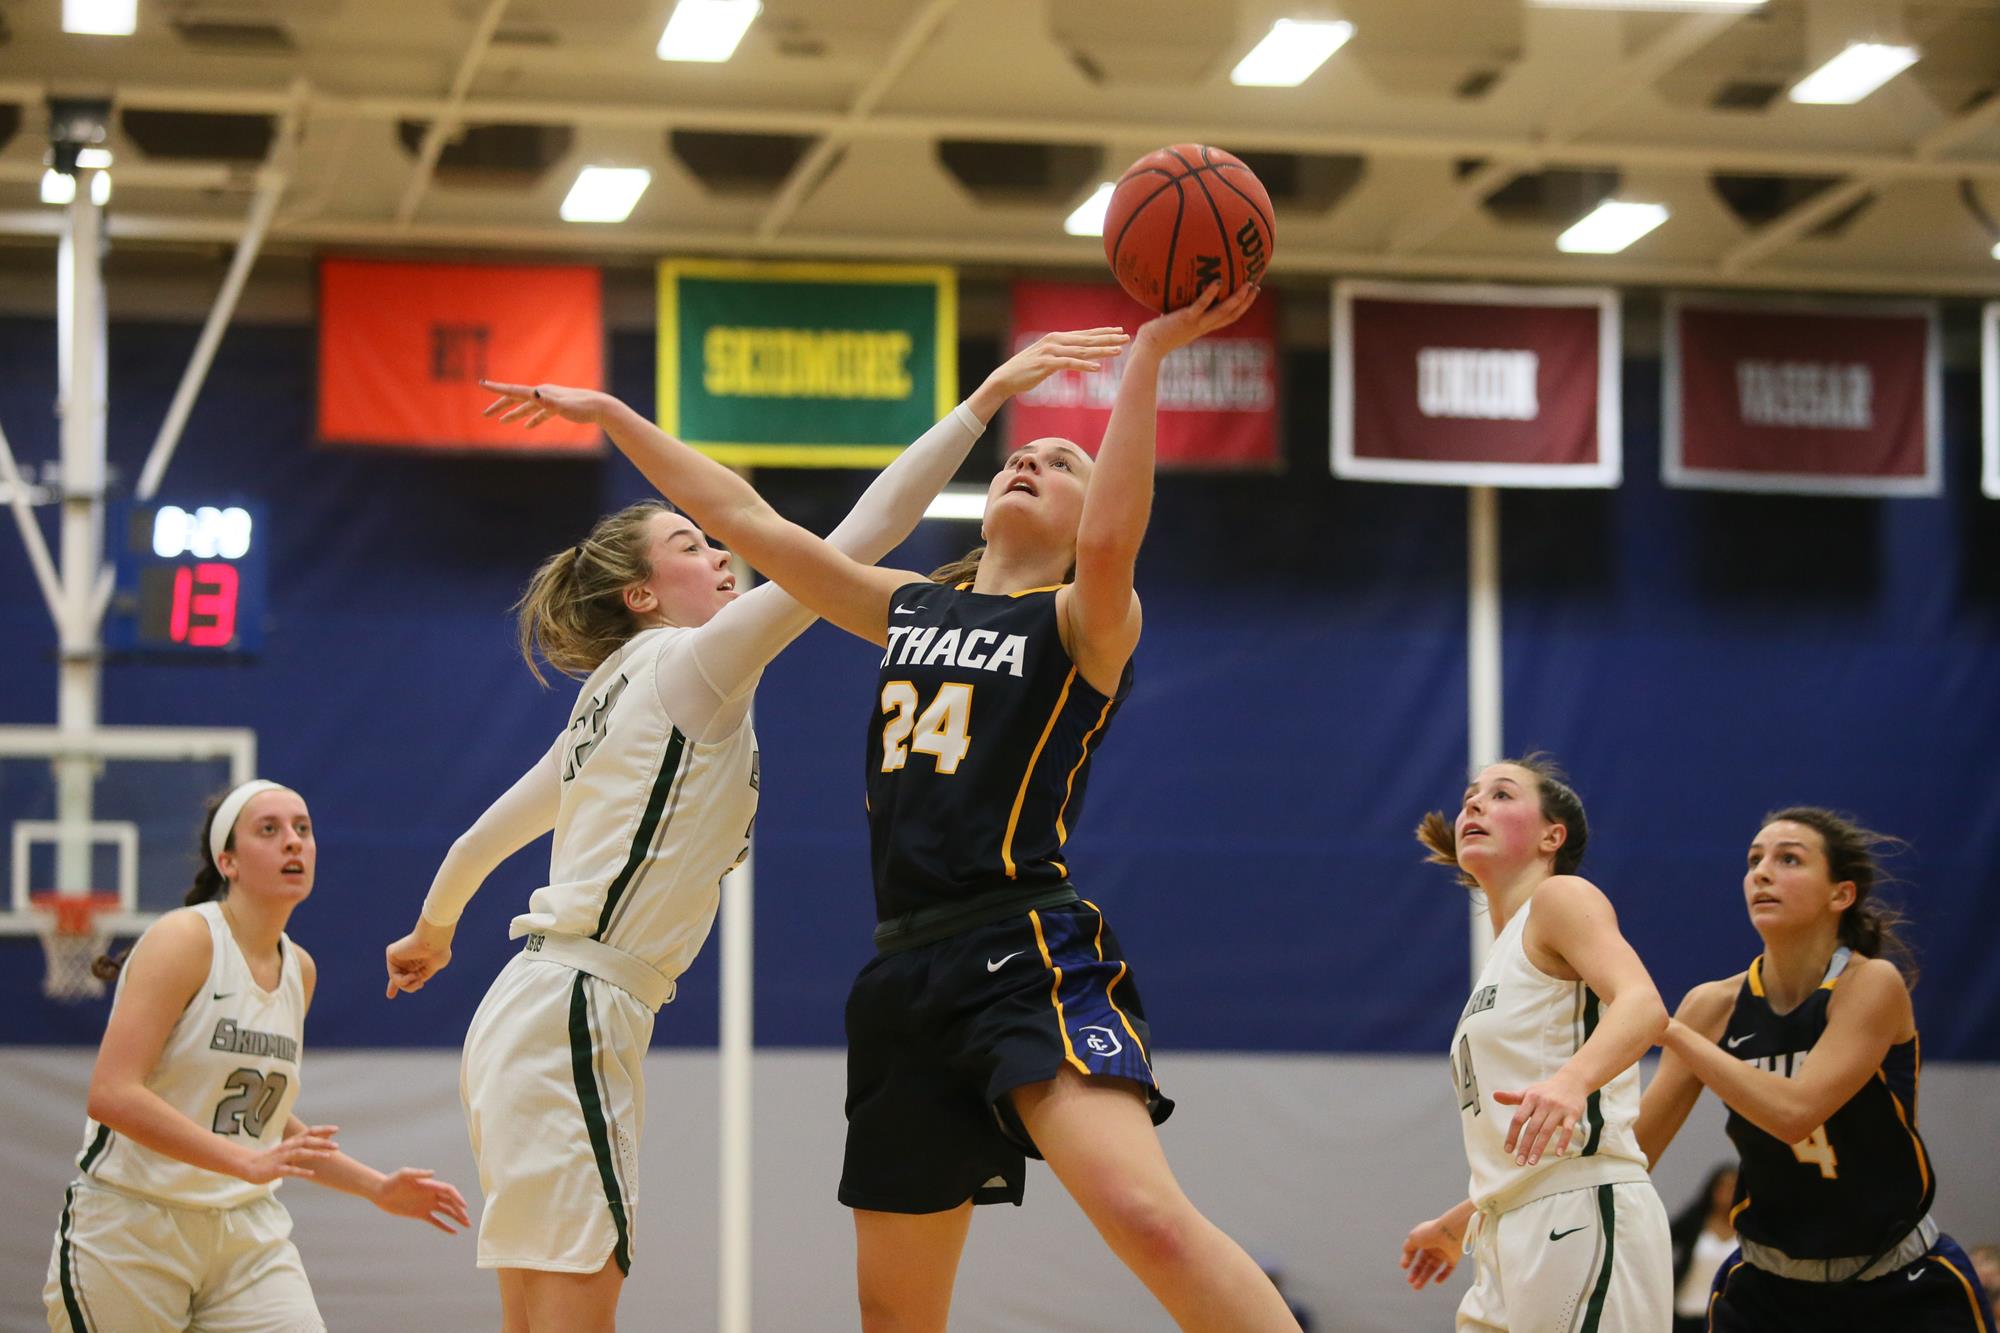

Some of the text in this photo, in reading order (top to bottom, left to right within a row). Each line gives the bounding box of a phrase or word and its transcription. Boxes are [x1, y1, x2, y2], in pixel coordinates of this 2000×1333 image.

[703, 326, 913, 398] SKIDMORE
[169, 562, 240, 647] 13
[880, 625, 1029, 678] THACA
[880, 680, 975, 775] 24
[212, 1067, 288, 1139] 20
[1790, 1122, 1839, 1180] 4
